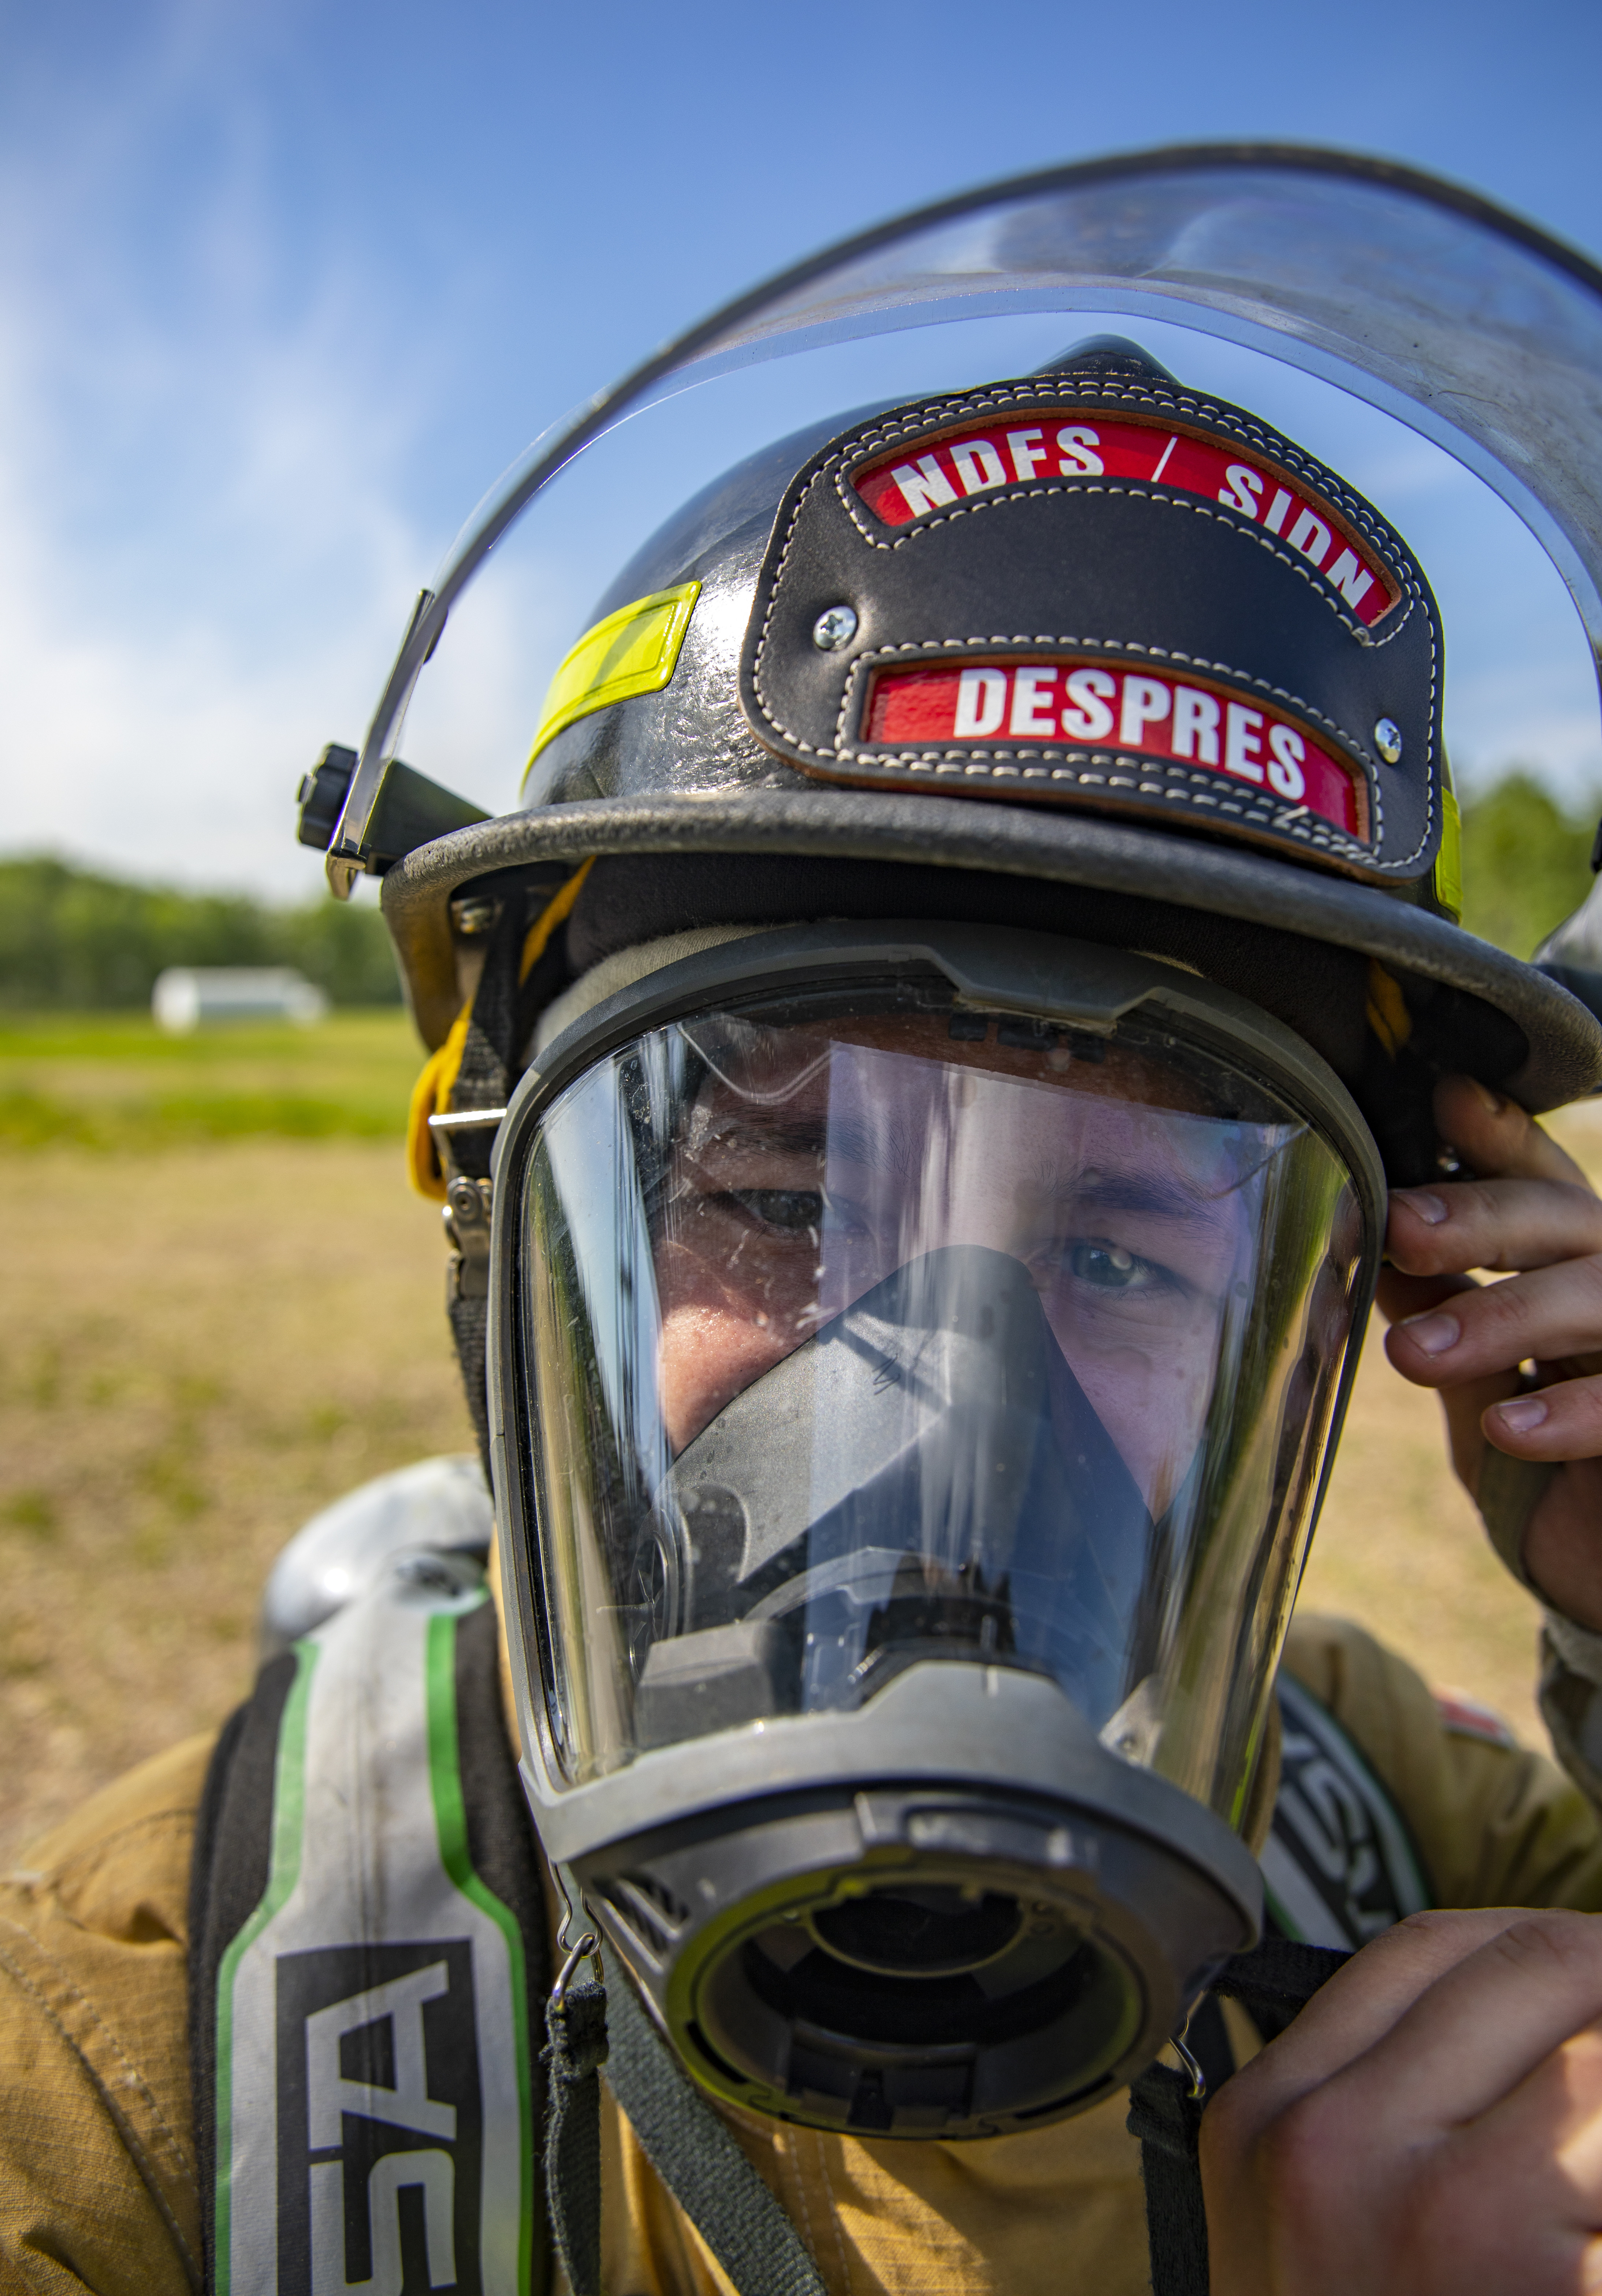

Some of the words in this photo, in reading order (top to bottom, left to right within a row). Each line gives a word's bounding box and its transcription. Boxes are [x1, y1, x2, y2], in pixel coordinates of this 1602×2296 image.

[891, 426, 1104, 518] NDFS
[1151, 437, 1178, 483] /
[1218, 464, 1374, 609] SIDN
[953, 667, 1306, 800] DESPRES
